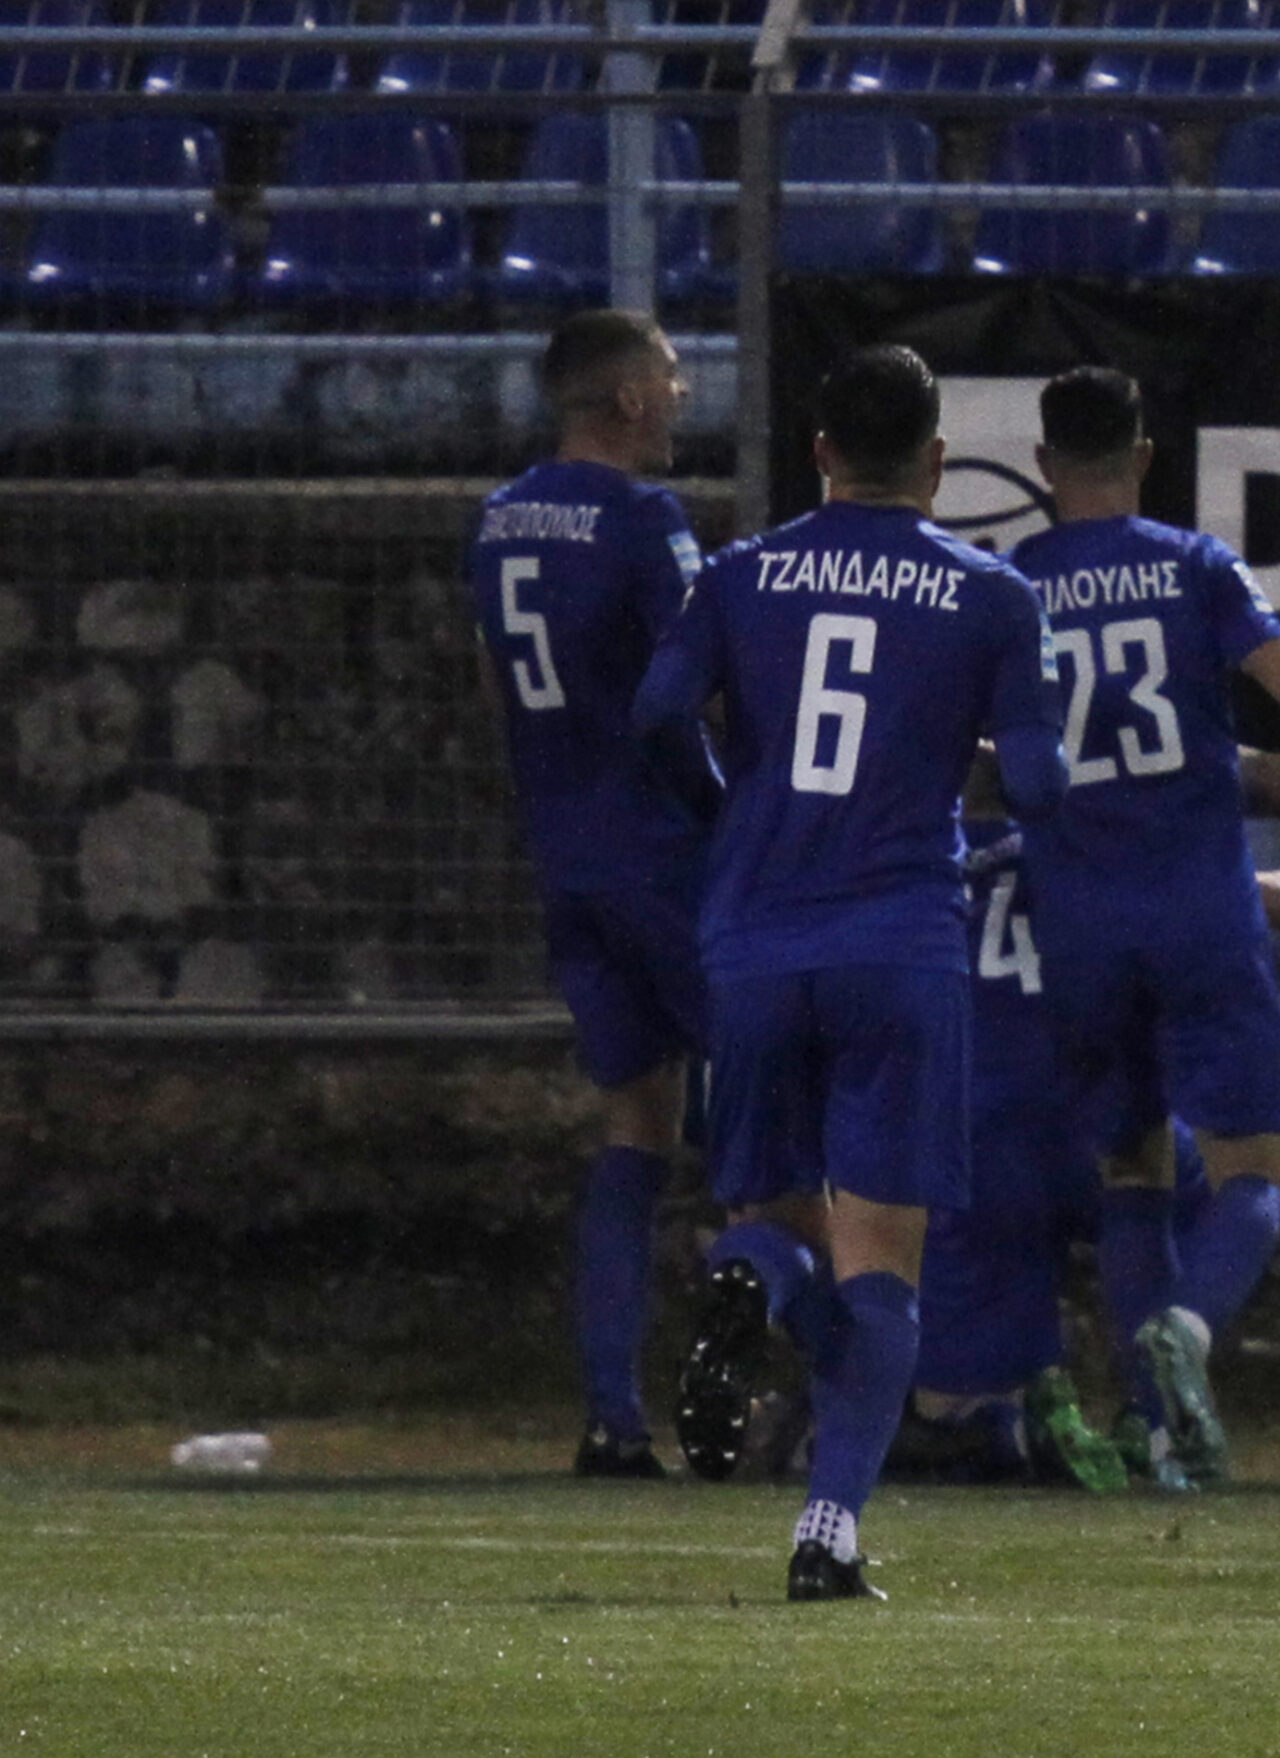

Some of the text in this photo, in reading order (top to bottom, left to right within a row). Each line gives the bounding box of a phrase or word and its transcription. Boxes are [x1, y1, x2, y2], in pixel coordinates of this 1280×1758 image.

[501, 556, 565, 709] 5
[757, 550, 966, 612] ΤΖΑΝΔΑΡΗΣ
[1029, 560, 1183, 614] ΙΛΟΥΛΗΣ
[791, 612, 878, 796] 6
[1052, 617, 1185, 787] 23
[978, 871, 1042, 993] 4
